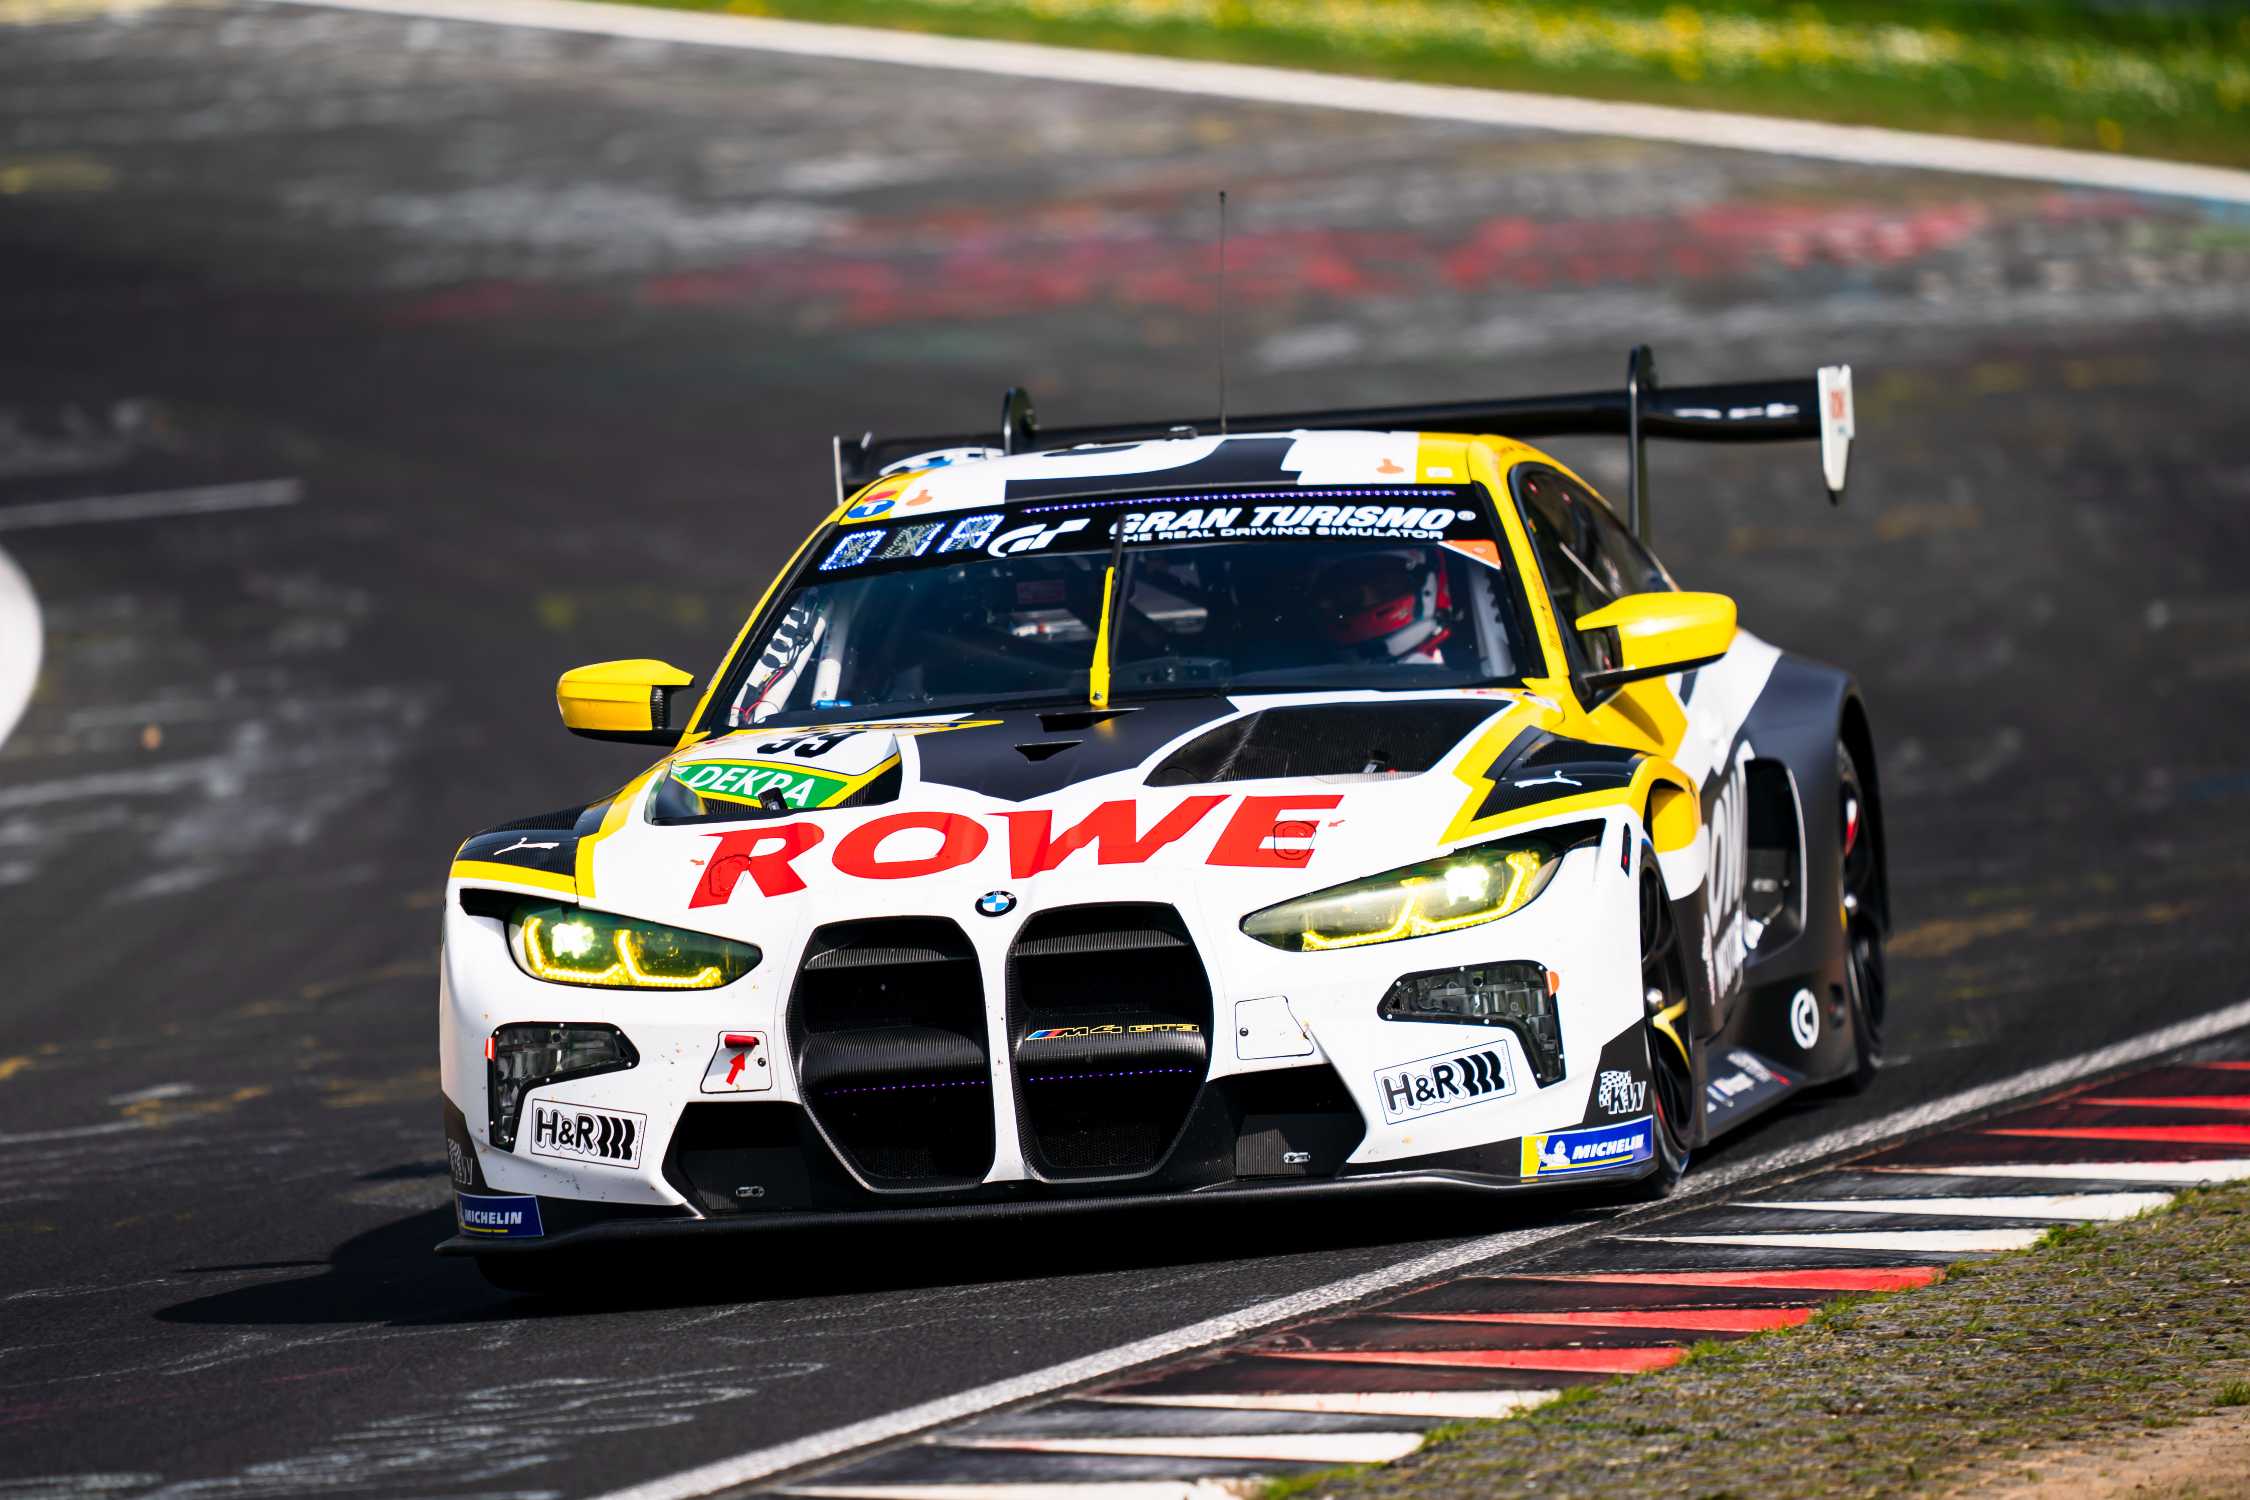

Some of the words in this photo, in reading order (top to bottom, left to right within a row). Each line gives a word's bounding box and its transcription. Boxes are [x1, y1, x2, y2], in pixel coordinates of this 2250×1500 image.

[1109, 507, 1242, 534] GRAN
[1250, 505, 1456, 531] TURISMO
[1158, 529, 1215, 540] REAL
[1220, 526, 1313, 538] DRIVING
[1316, 527, 1444, 540] SIMULATOR
[688, 766, 816, 807] DEKRA
[687, 793, 1345, 910] ROWE
[1381, 1063, 1462, 1114] H&R
[1607, 1081, 1647, 1114] KW
[535, 1107, 598, 1154] H&R
[1571, 1133, 1646, 1161] MICHELIN
[464, 1208, 523, 1225] MICHELIN
